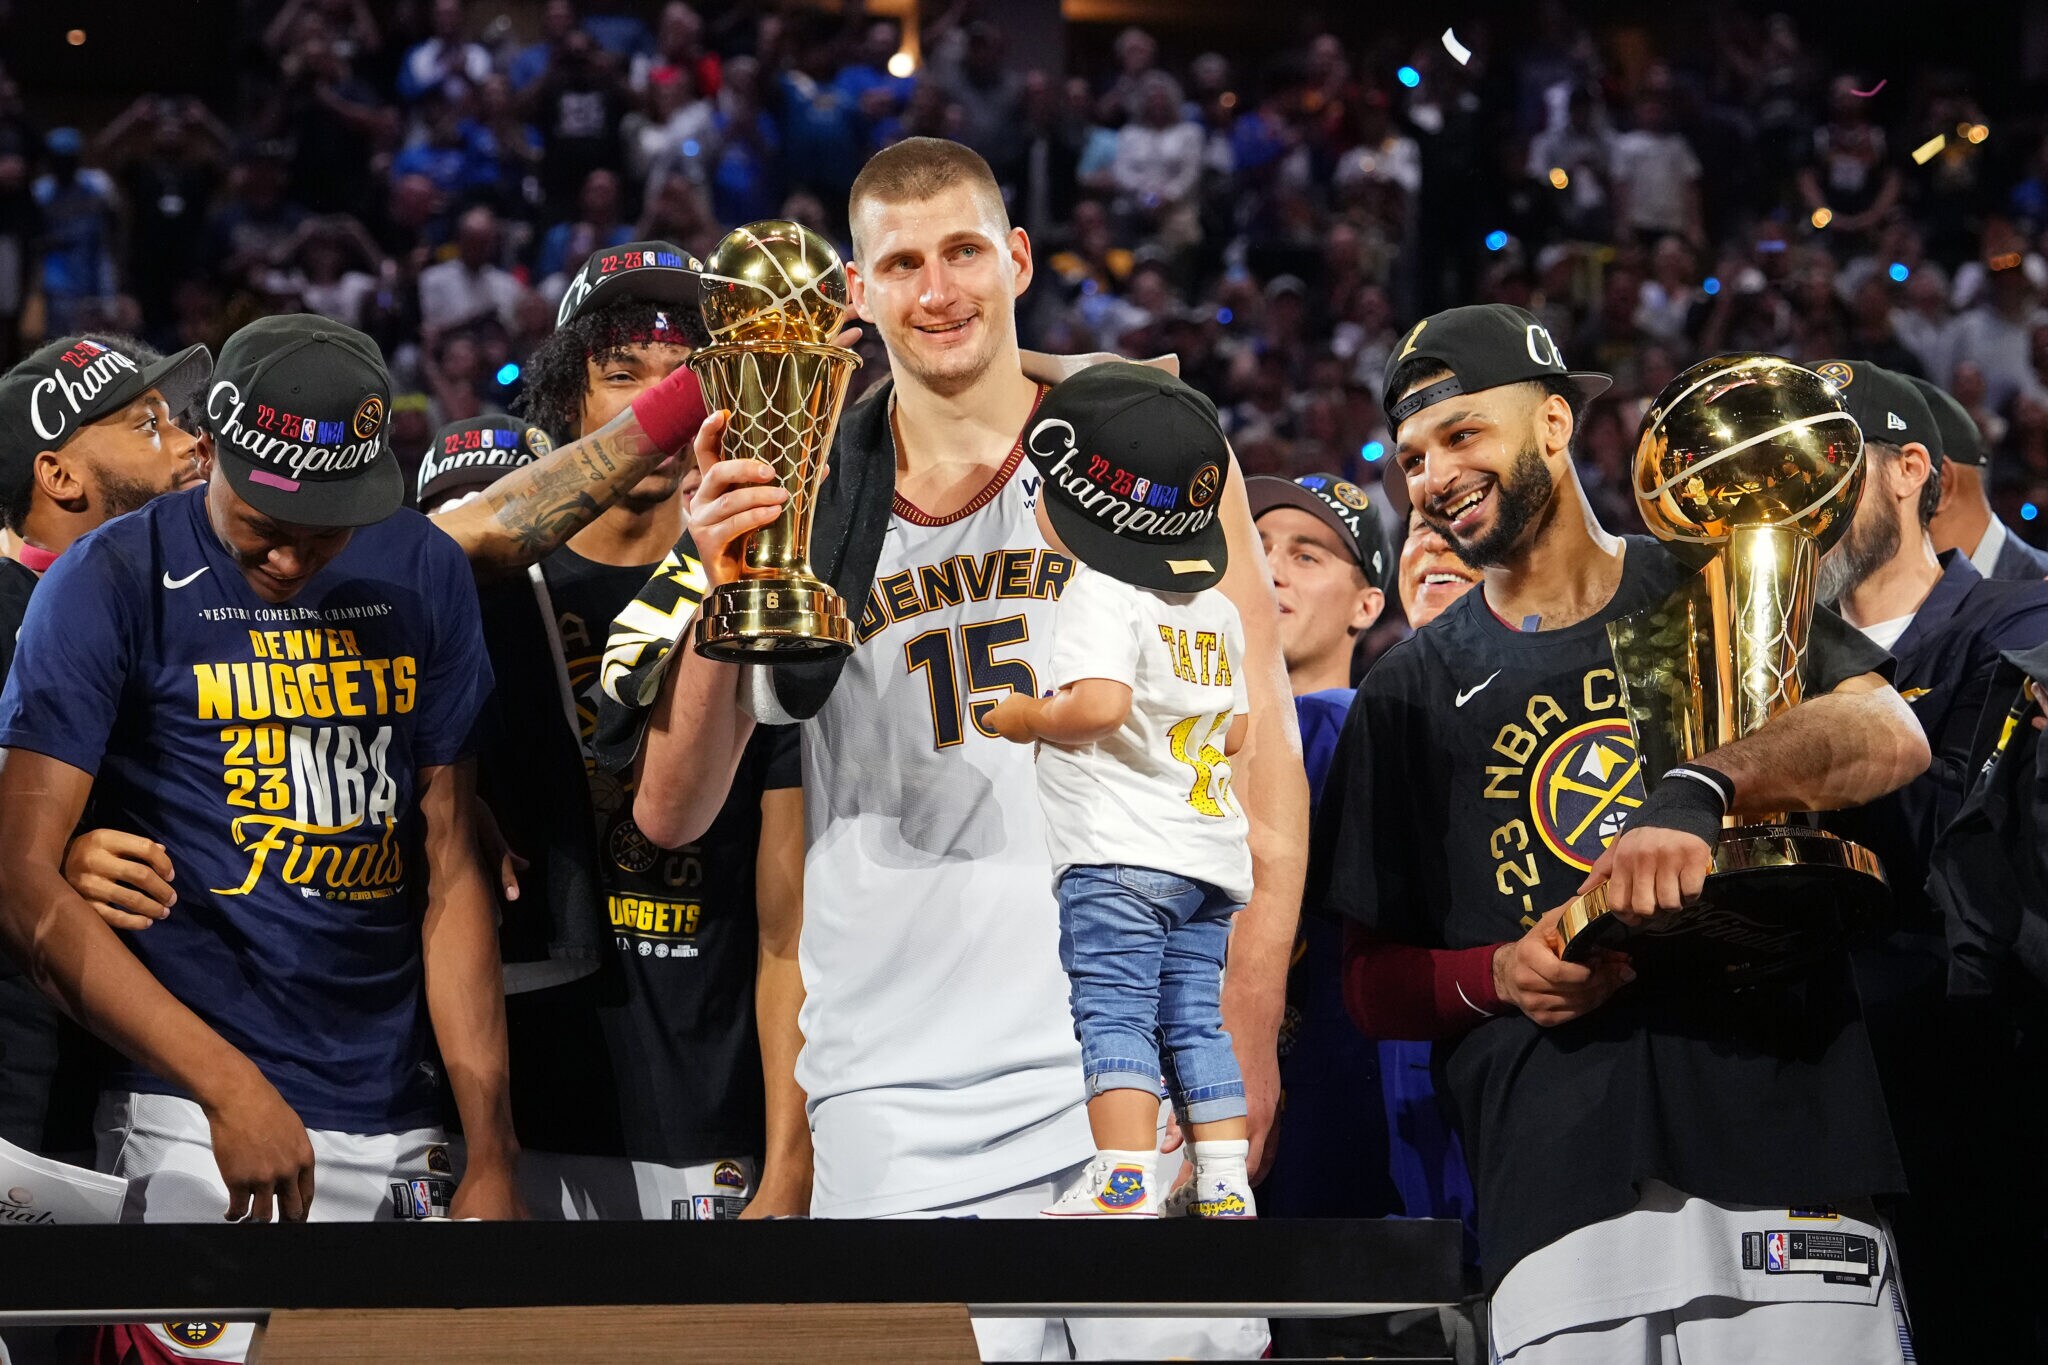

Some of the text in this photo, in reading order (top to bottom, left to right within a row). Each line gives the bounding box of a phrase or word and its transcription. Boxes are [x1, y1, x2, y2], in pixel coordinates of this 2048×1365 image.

[601, 251, 642, 273] 22-23
[207, 380, 381, 479] Champions
[257, 404, 344, 445] 22-23 NBA
[444, 430, 481, 454] 22-23
[1028, 418, 1214, 534] Champions
[1087, 454, 1179, 509] 22-23 NBA
[254, 608, 322, 622] CONFERENCE
[325, 603, 388, 622] CHAMPIONS
[766, 592, 779, 609] 6
[248, 628, 362, 661] DENVER
[1158, 624, 1232, 686] TATA
[192, 656, 417, 720] NUGGETS
[904, 613, 1039, 748] 15
[220, 722, 286, 766] 20
[1483, 694, 1568, 799] NBA
[223, 767, 290, 811] 23
[289, 725, 398, 828] NBA
[209, 814, 404, 895] Finals
[1793, 1242, 1803, 1250] 52
